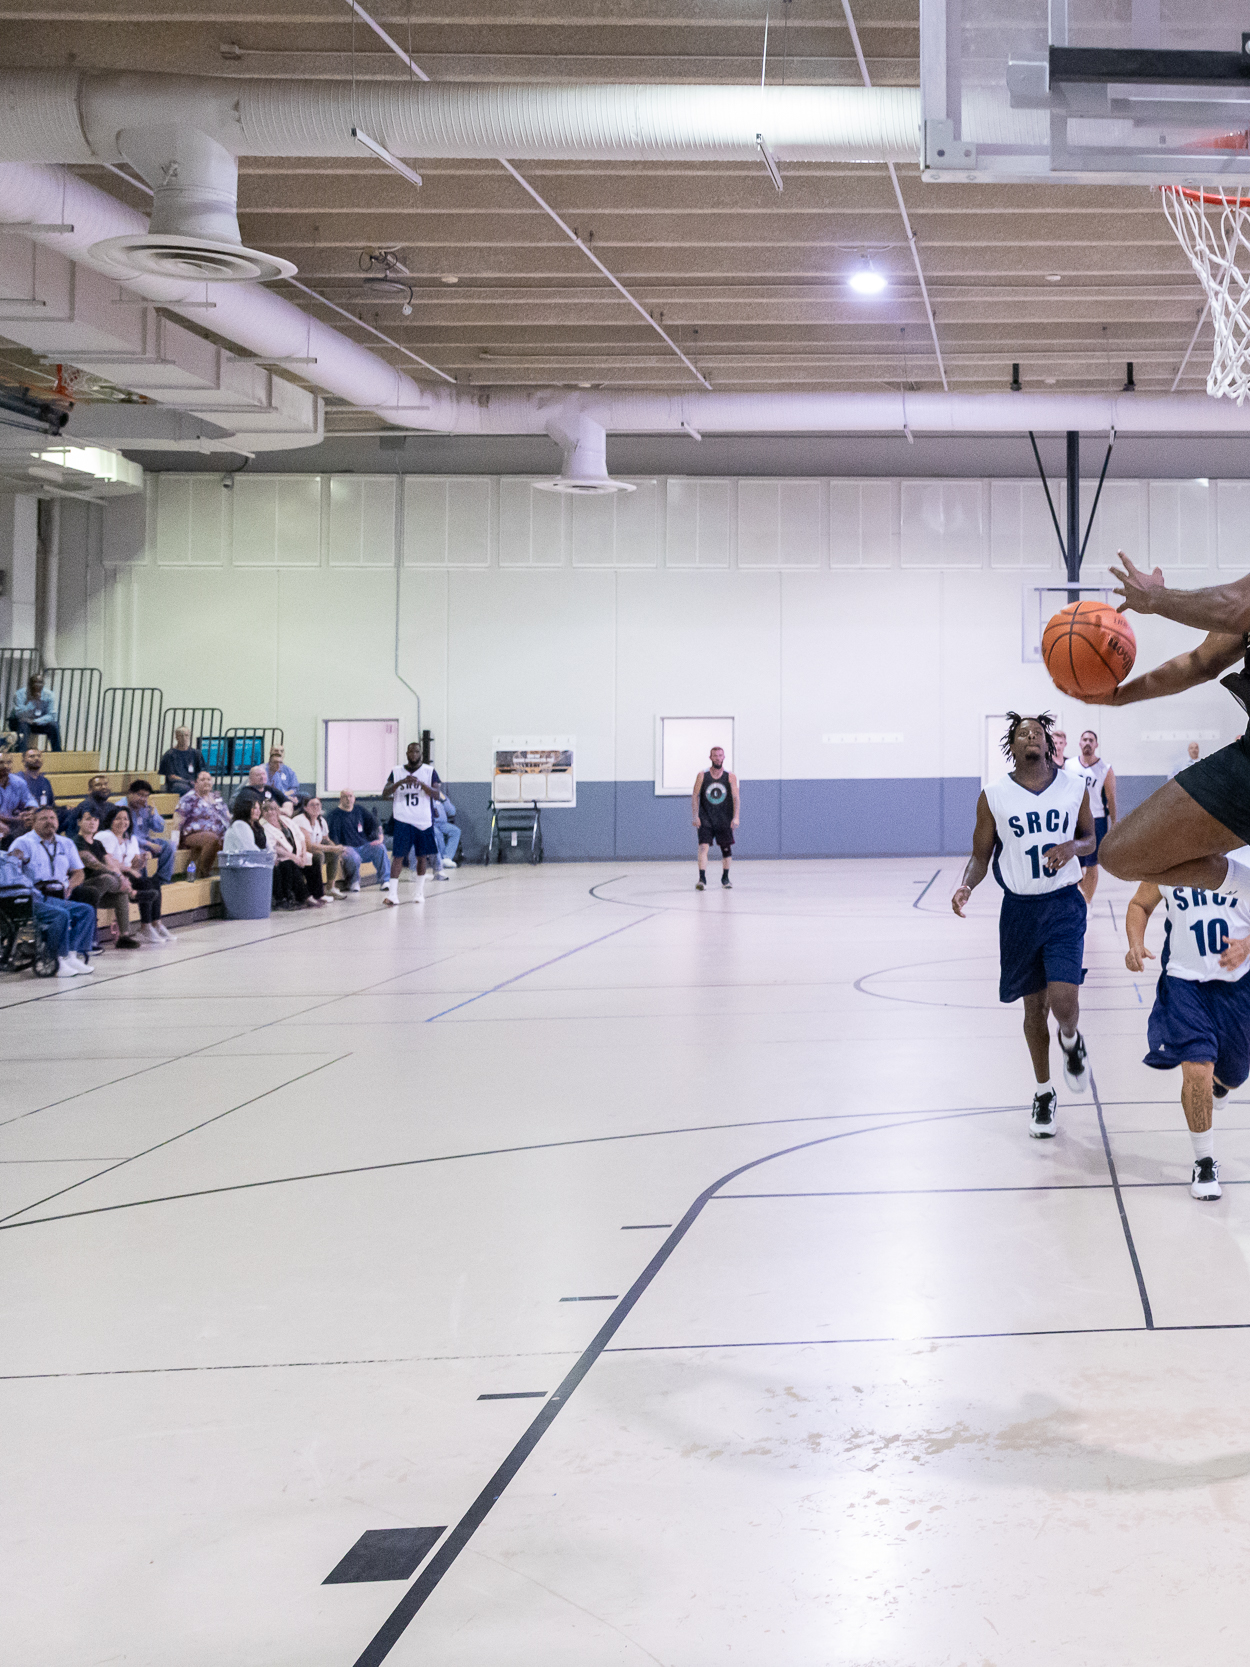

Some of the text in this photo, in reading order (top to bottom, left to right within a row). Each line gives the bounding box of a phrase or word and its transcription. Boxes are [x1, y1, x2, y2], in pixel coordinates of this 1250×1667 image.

[405, 793, 419, 807] 15
[1008, 809, 1069, 838] SRCI
[1189, 918, 1229, 957] 10
